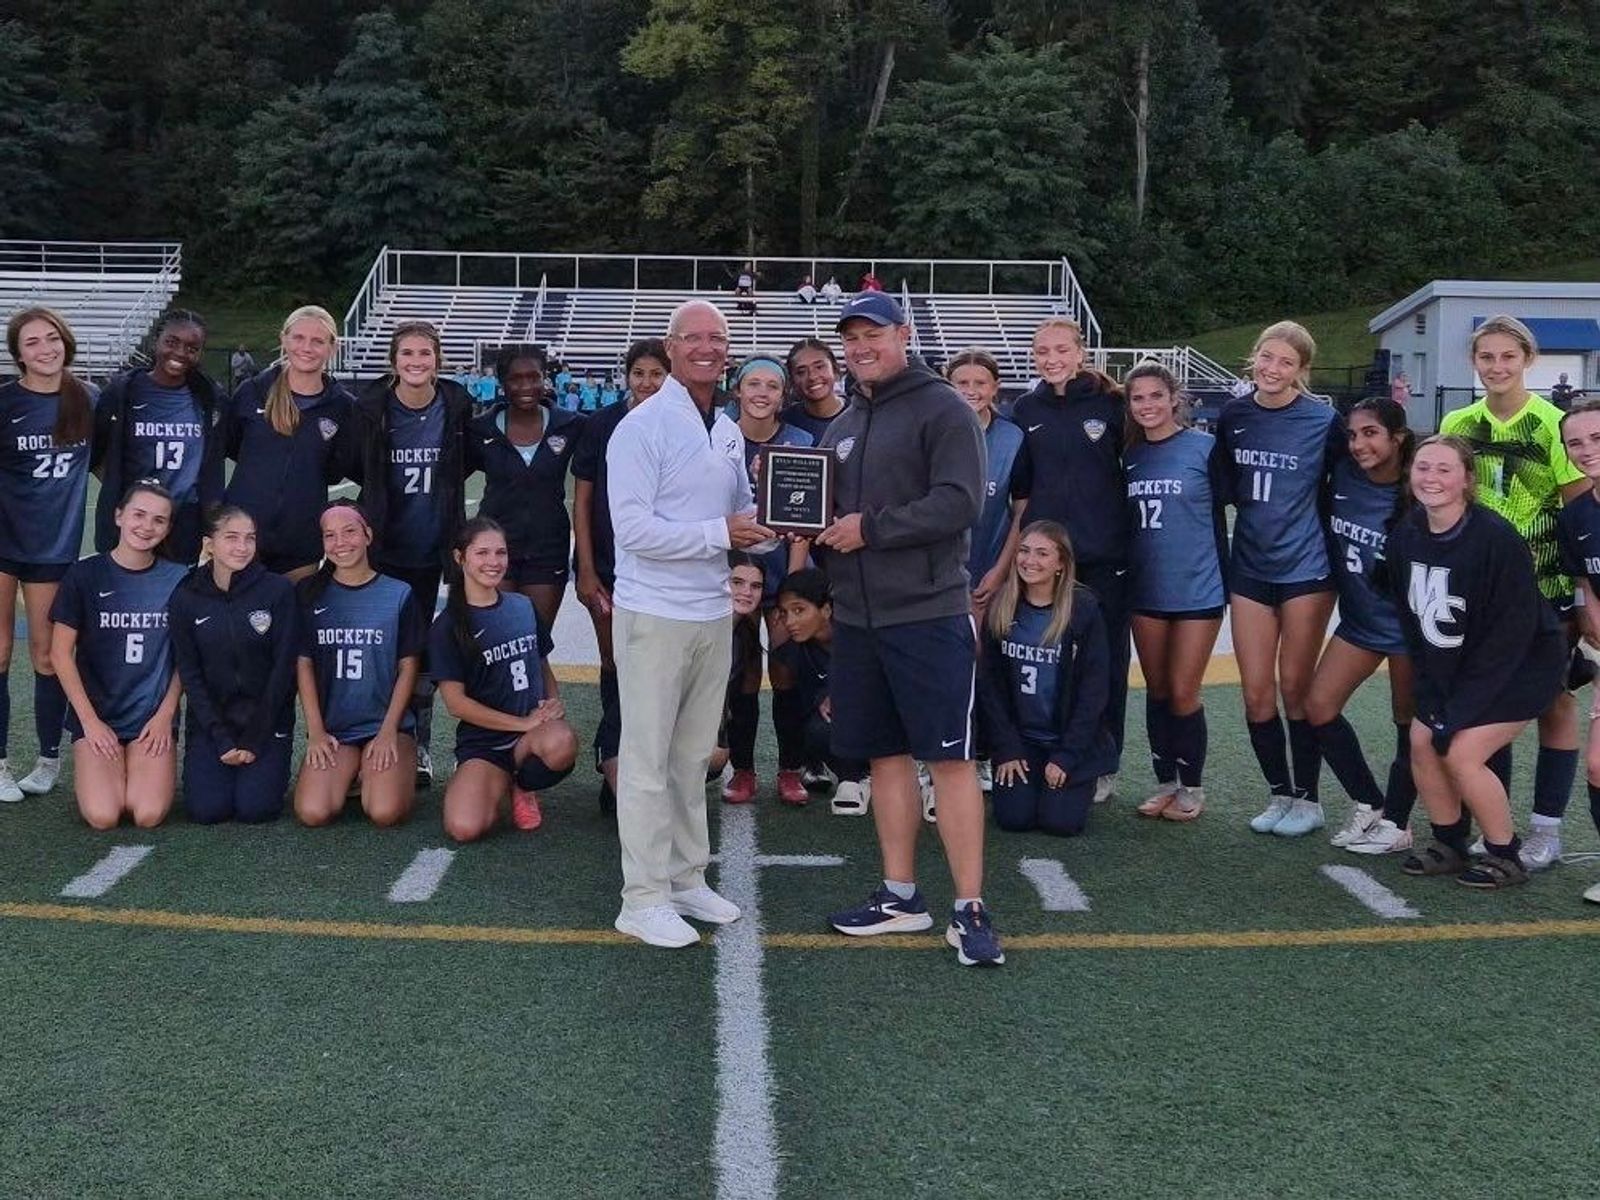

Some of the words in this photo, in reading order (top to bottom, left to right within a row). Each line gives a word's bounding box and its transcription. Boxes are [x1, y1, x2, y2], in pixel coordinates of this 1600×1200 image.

[135, 422, 201, 438] ROCKETS
[156, 441, 184, 470] 13
[391, 447, 441, 463] OCKET
[1235, 448, 1298, 470] ROCKETS
[404, 467, 431, 494] 21
[1252, 471, 1272, 502] 11
[1139, 500, 1163, 529] 12
[1346, 543, 1363, 574] 5
[99, 611, 169, 629] ROCKETS
[125, 633, 144, 664] 6
[317, 628, 384, 645] ROCKETS
[482, 634, 537, 666] ROCKET
[336, 649, 363, 680] 15
[510, 659, 529, 692] 8
[1020, 665, 1038, 695] 3
